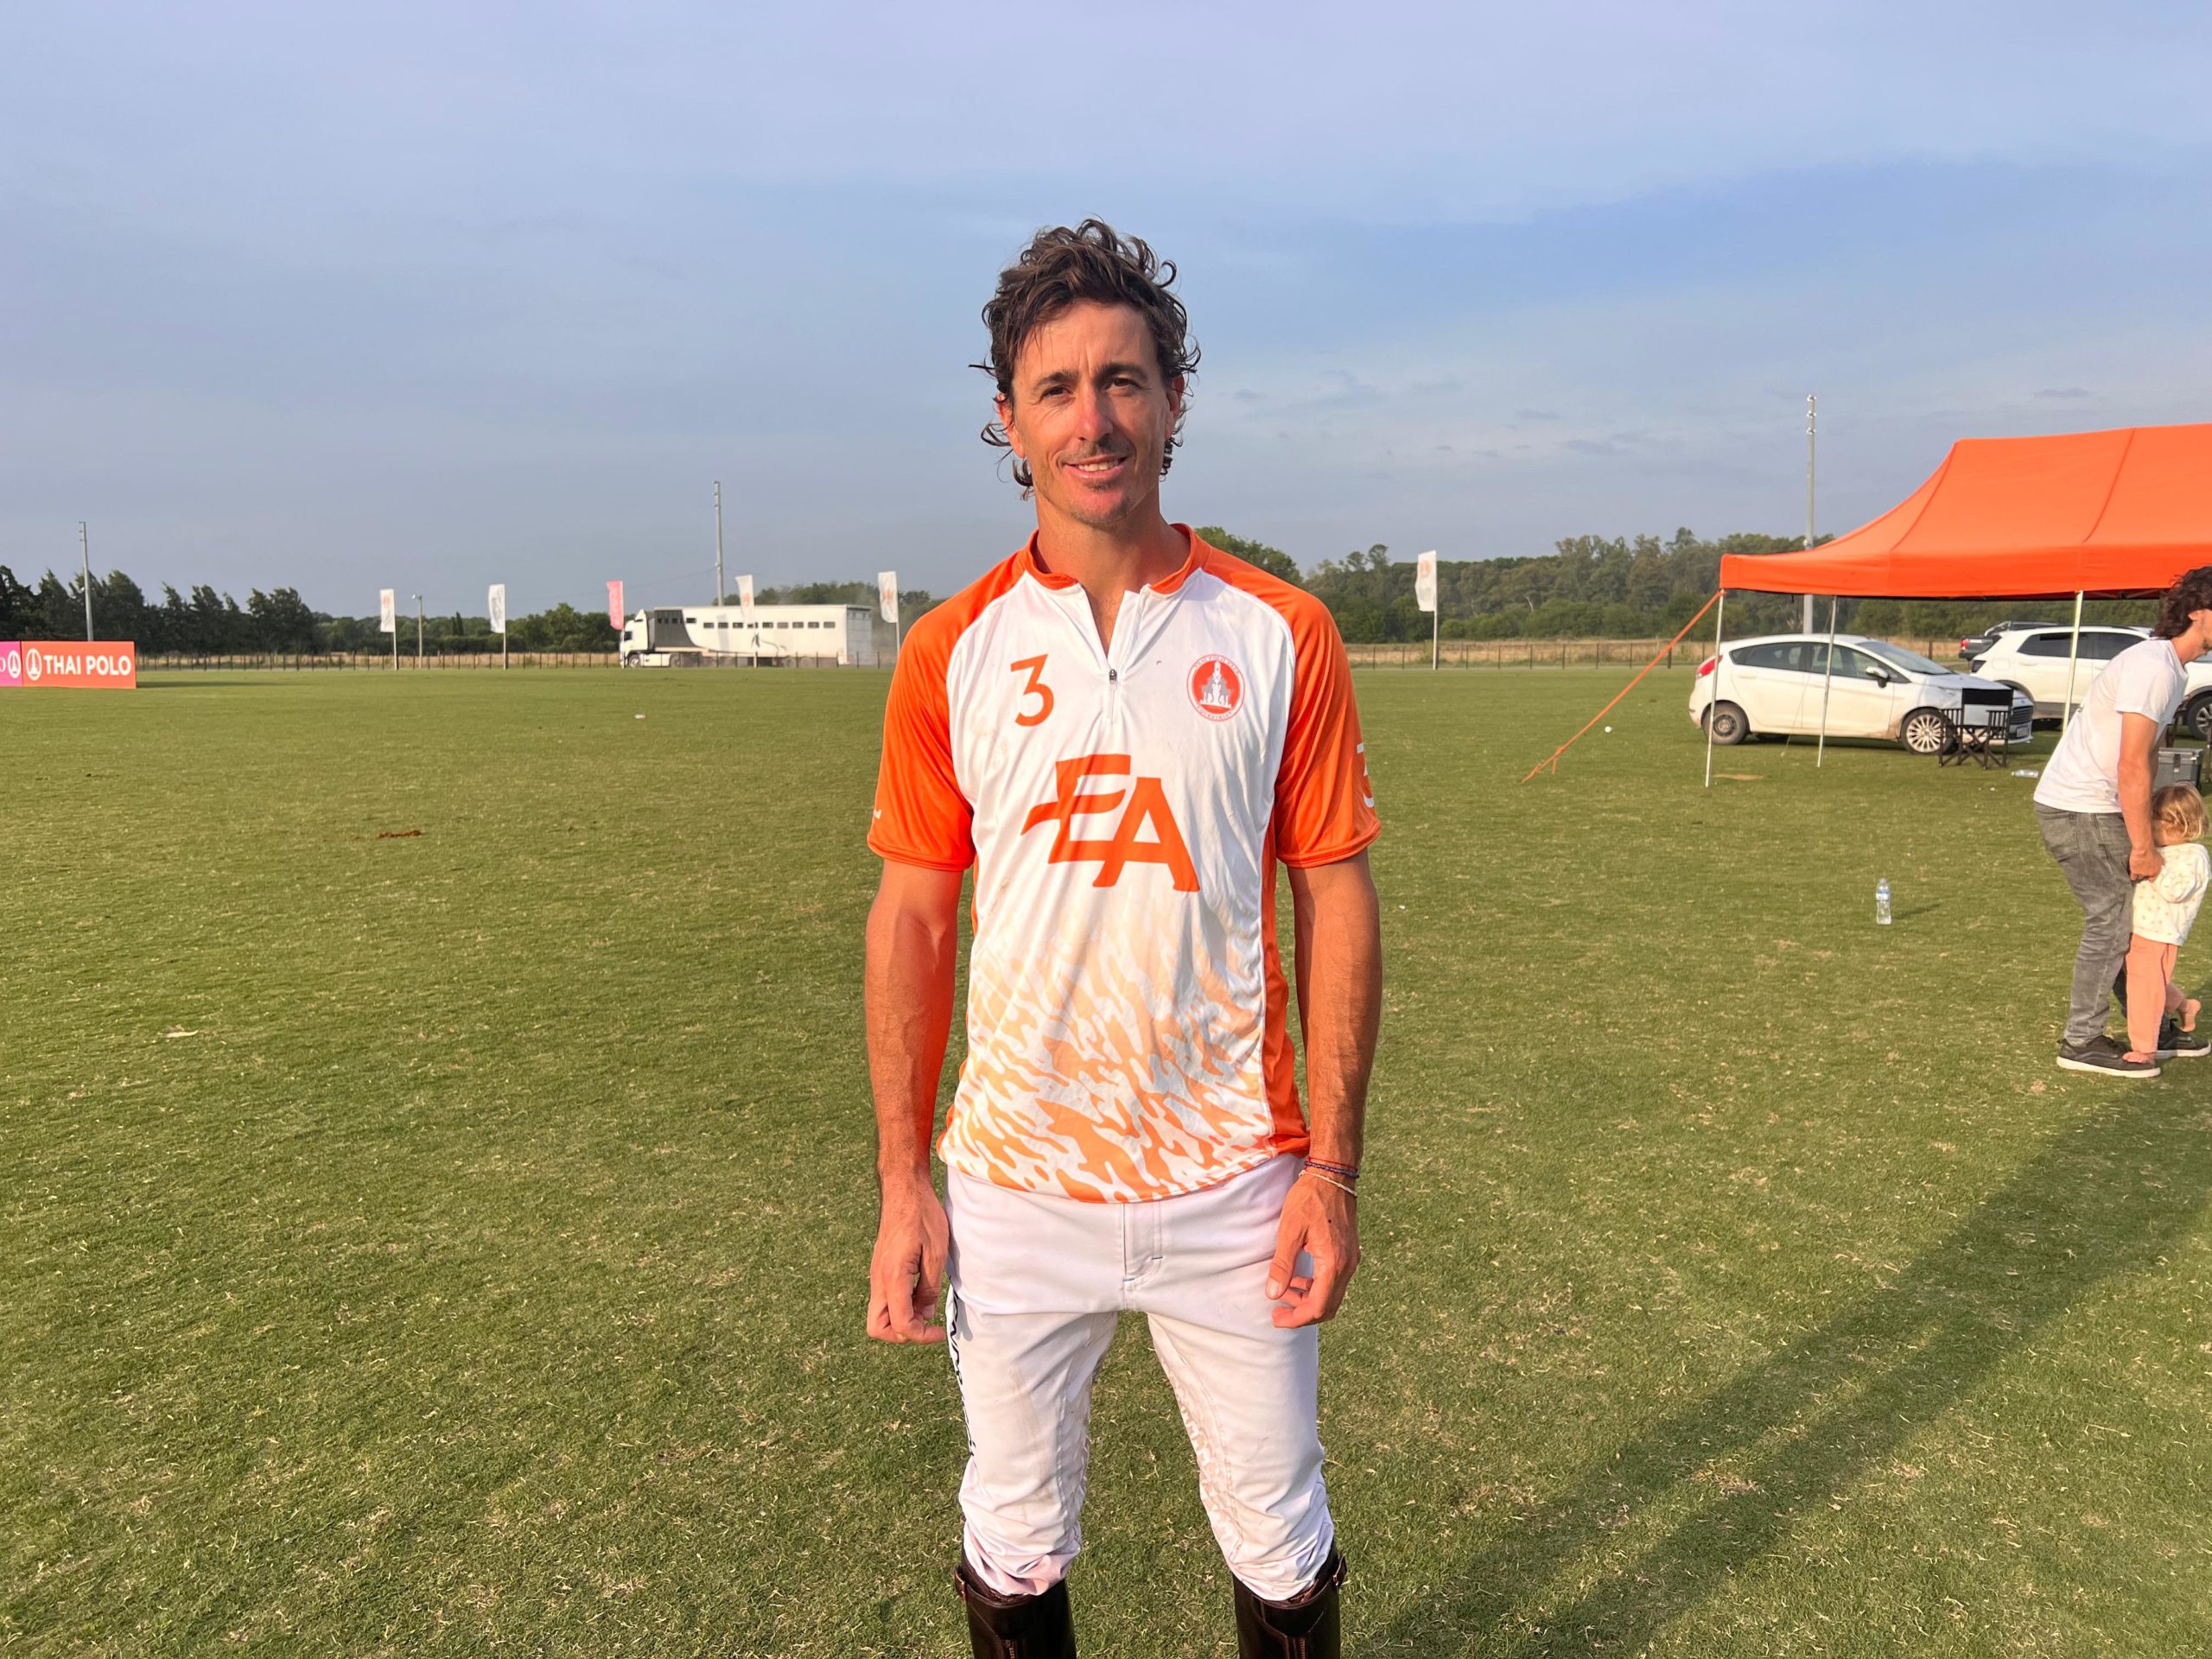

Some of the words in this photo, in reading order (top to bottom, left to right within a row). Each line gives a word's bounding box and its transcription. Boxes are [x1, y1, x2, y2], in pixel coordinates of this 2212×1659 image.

[44, 655, 81, 675] THAI
[86, 655, 131, 676] POLO
[1010, 653, 1054, 727] 3
